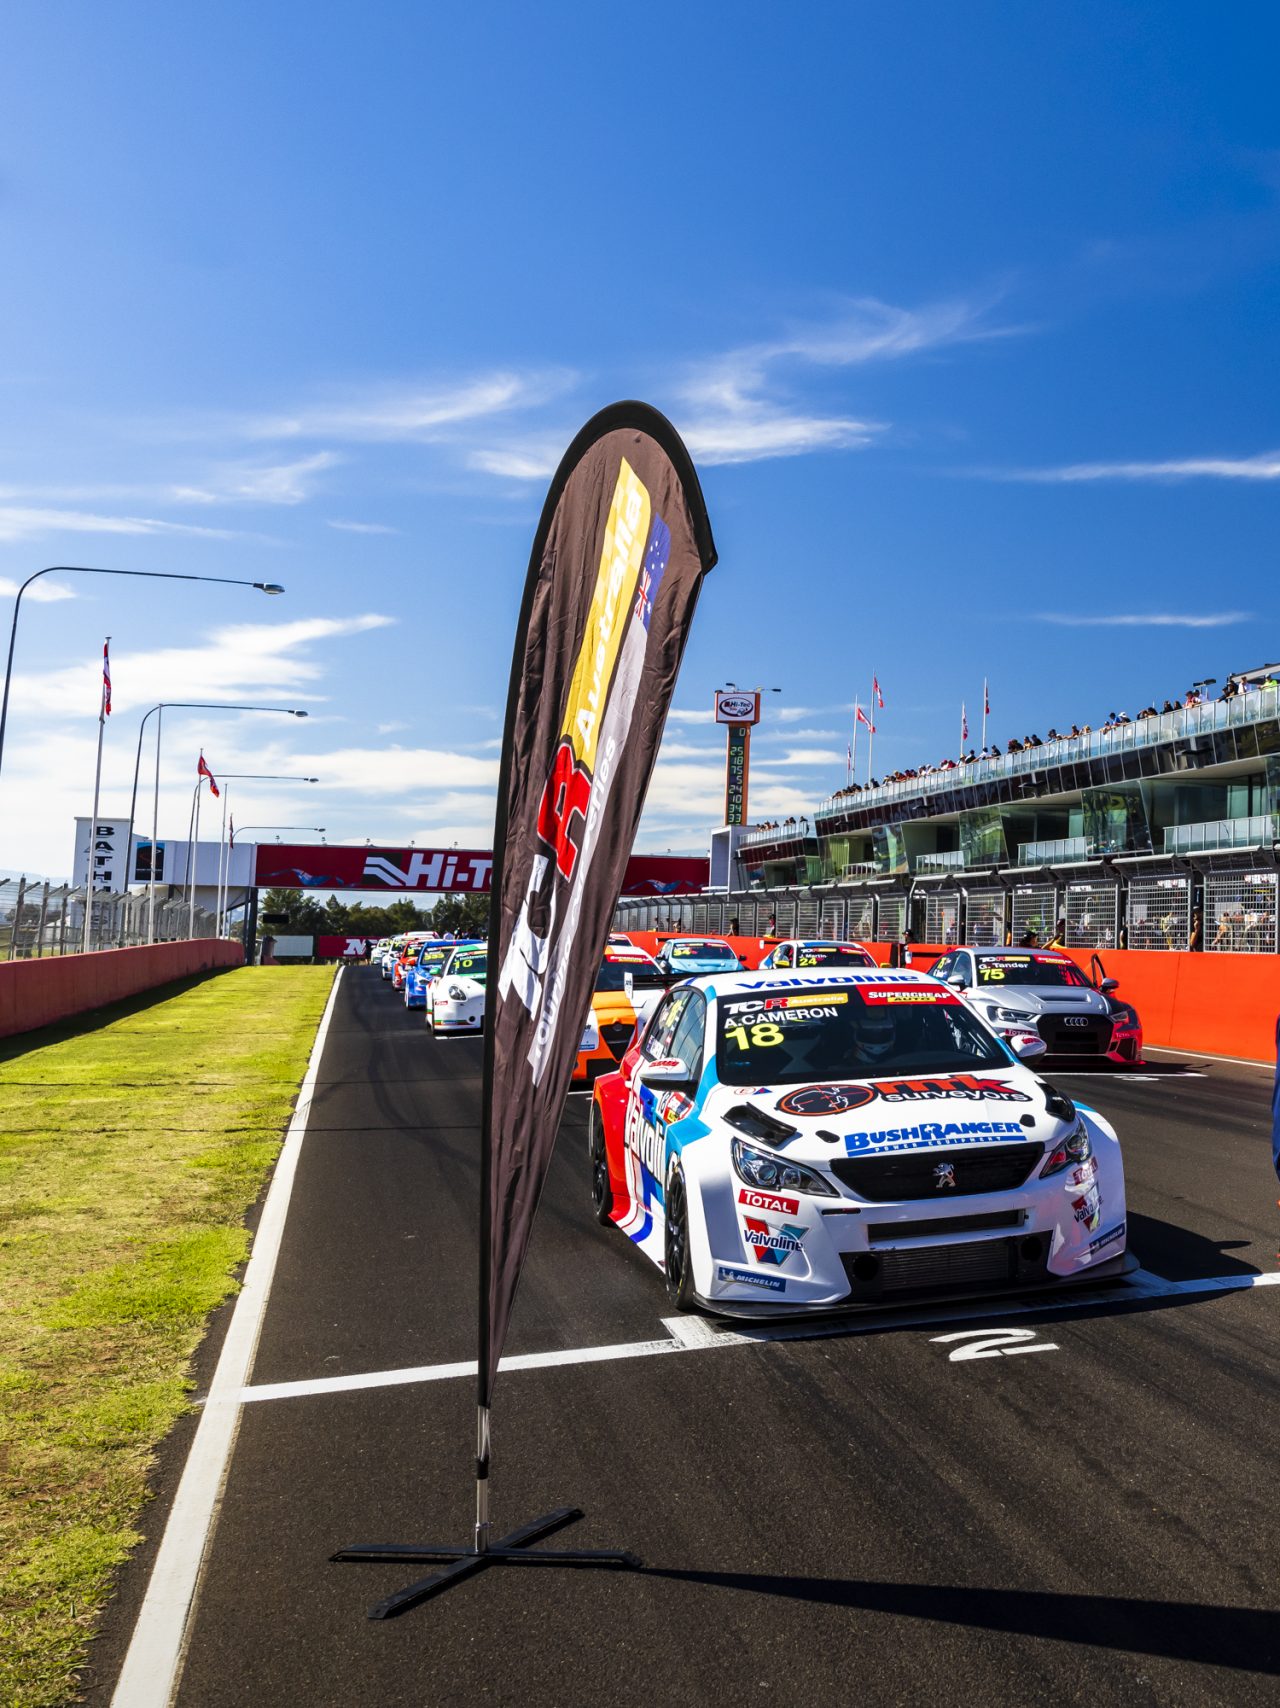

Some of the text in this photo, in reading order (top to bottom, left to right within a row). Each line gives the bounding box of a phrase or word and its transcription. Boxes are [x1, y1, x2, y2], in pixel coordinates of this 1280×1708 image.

[575, 489, 645, 752] Australia
[730, 700, 751, 709] Hi-Tec
[738, 727, 746, 737] 0
[730, 746, 743, 756] 25
[733, 756, 744, 765] 18
[731, 765, 743, 775] 75
[736, 775, 743, 785] 5
[729, 784, 743, 794] 24
[732, 794, 742, 804] 10
[728, 803, 742, 813] 34
[728, 813, 741, 823] 33
[406, 852, 493, 889] Hi-T
[497, 741, 594, 1021] TCR
[453, 959, 473, 969] 10
[799, 957, 818, 967] 24
[992, 962, 1029, 970] Tander
[980, 968, 1006, 981] 75
[735, 975, 920, 989] Valvoline
[868, 991, 951, 999] SUPERCHEAP
[723, 995, 845, 1015] TCR Australia
[723, 1006, 839, 1029] A.CAMERON
[725, 1023, 785, 1051] 18
[873, 1075, 1020, 1093] rmk
[886, 1087, 1030, 1102] surveyors
[874, 1136, 1002, 1153] POWER EQUIPMENT
[744, 1190, 793, 1214] TOTAL
[744, 1229, 803, 1252] Valvoline
[736, 1274, 782, 1289] MICHELIN
[929, 1327, 1060, 1362] 2
